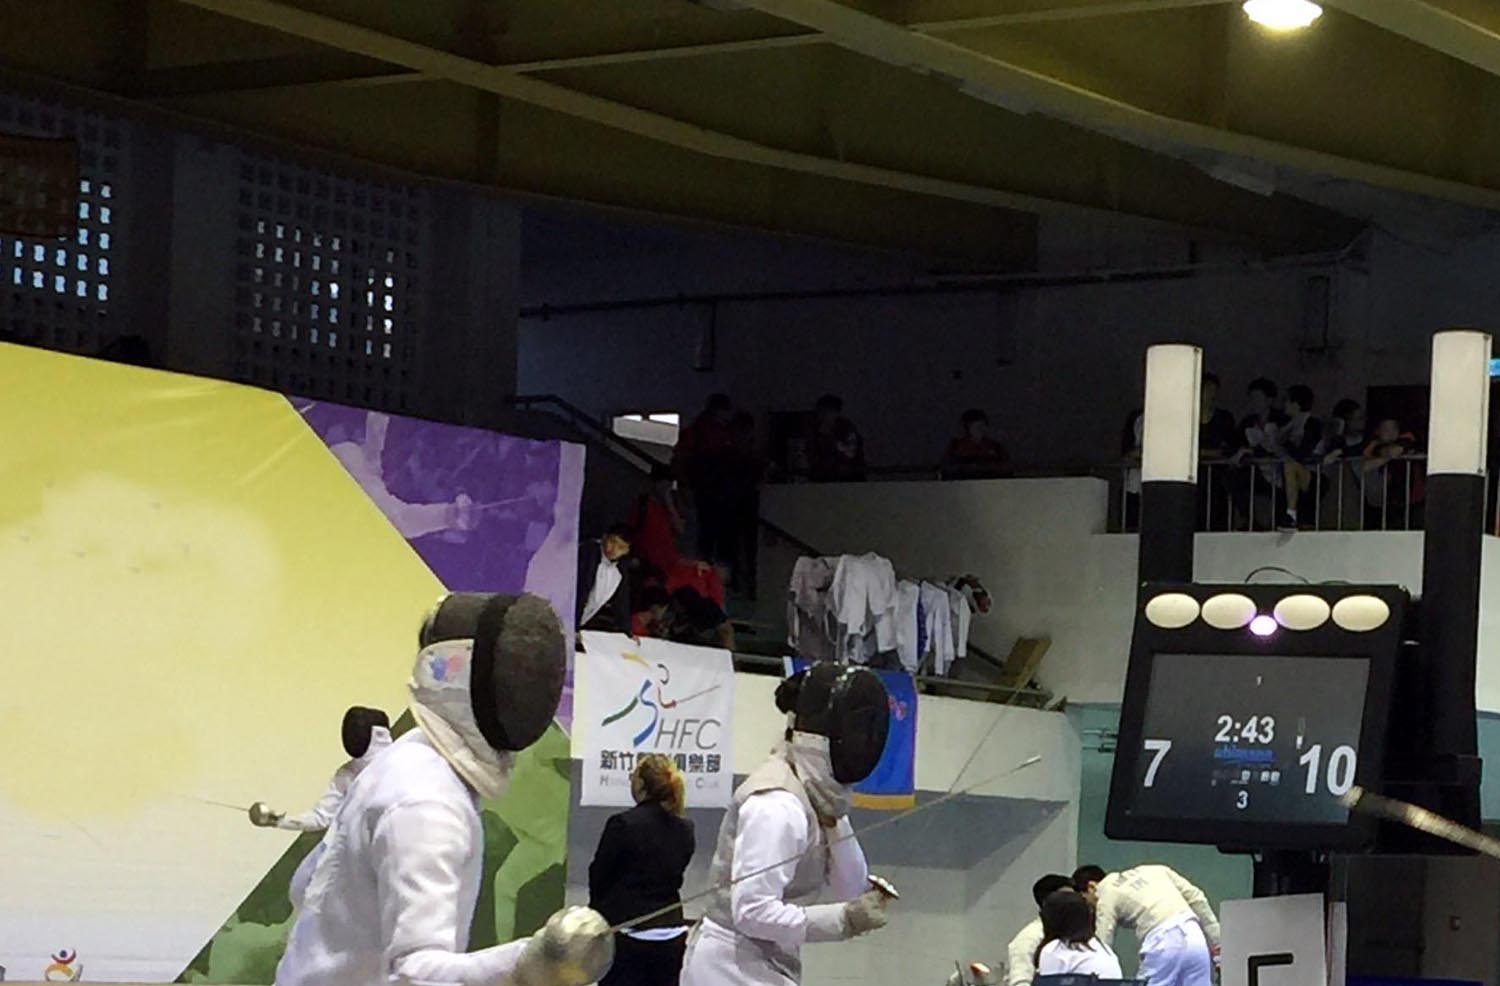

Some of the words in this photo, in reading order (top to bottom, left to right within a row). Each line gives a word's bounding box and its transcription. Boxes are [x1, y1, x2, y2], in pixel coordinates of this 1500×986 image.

[654, 718, 721, 749] HFC
[1214, 715, 1275, 743] 2:43
[601, 750, 721, 773] 新竹俱樂部
[1143, 739, 1172, 787] 7
[1300, 744, 1357, 796] 10
[1236, 791, 1249, 809] 3
